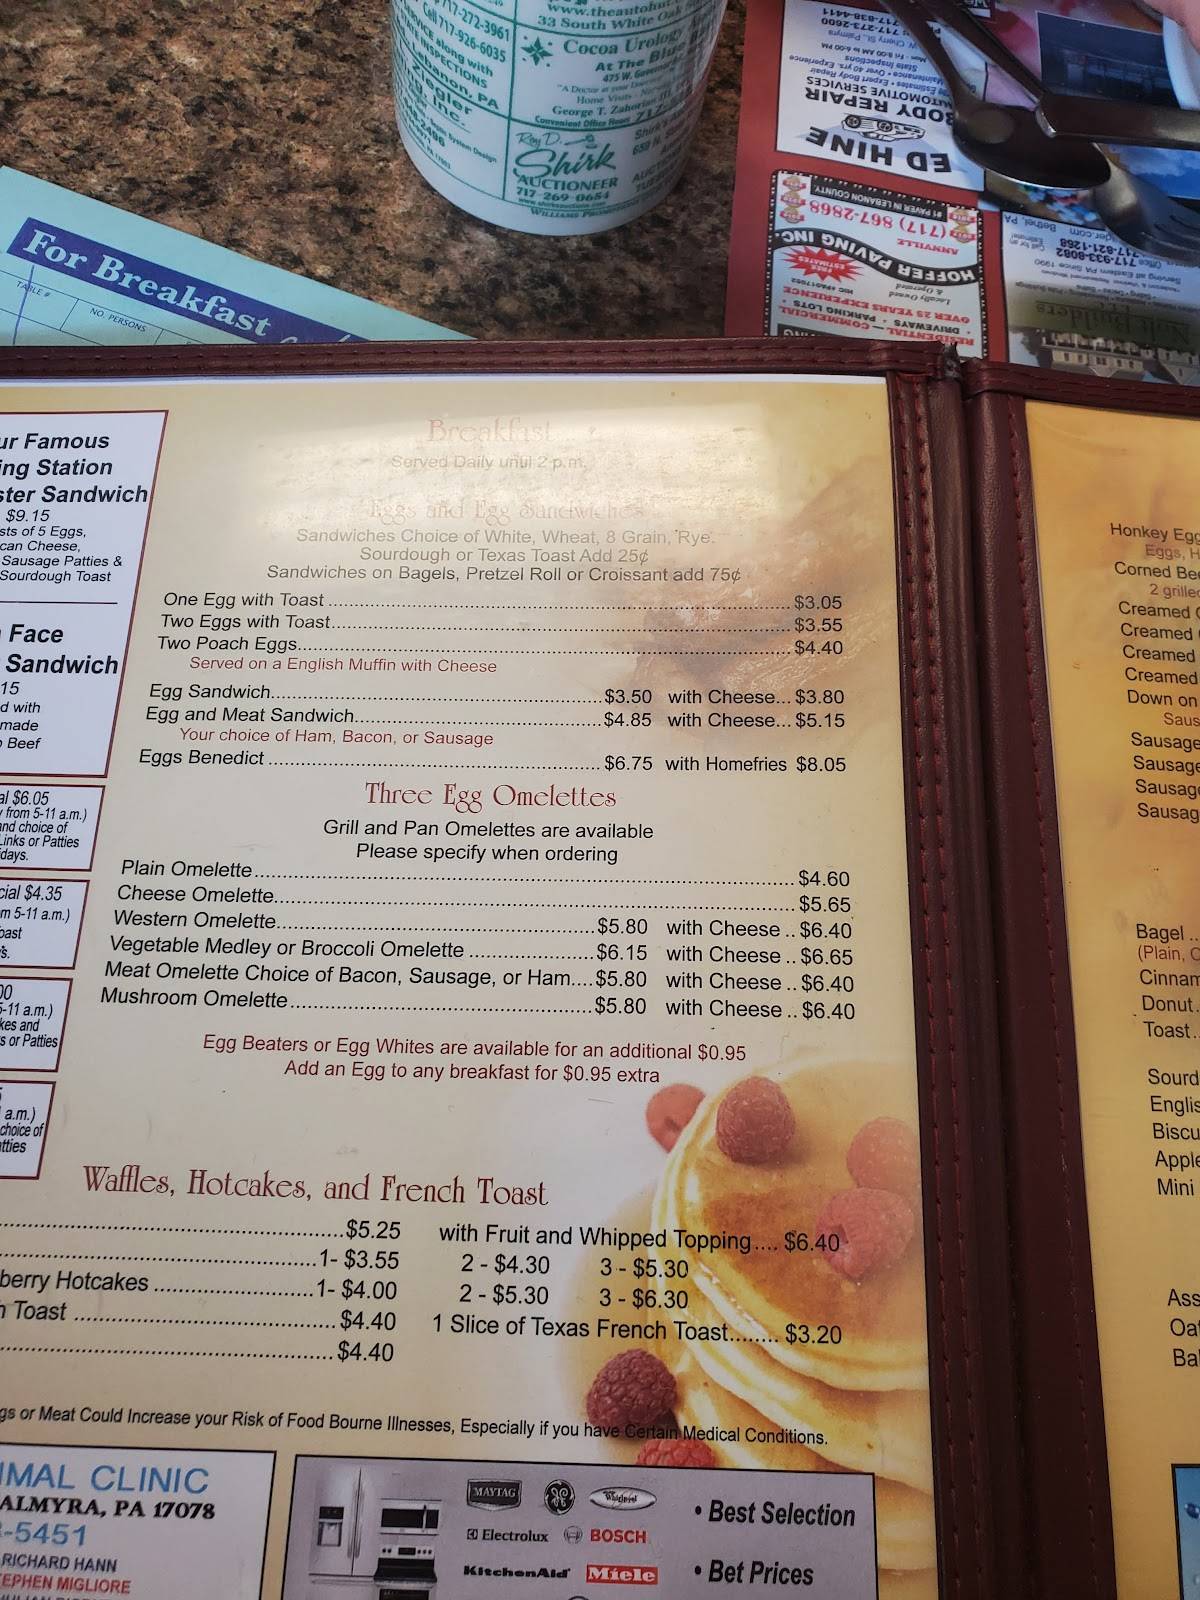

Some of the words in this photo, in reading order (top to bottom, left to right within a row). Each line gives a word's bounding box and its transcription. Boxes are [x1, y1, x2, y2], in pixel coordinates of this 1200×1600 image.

[538, 16, 556, 27] 33
[561, 18, 606, 30] South
[612, 17, 653, 29] White
[821, 18, 898, 35] 717-273-2600
[439, 16, 505, 62] 717-926-6035
[564, 40, 618, 55] Cocoa
[622, 27, 682, 54] Urology
[421, 36, 487, 88] INSPECTIONS
[596, 62, 614, 72] At
[618, 59, 645, 69] The
[789, 55, 835, 68] Experience
[845, 55, 894, 68] Inspections
[853, 65, 864, 73] 40
[897, 62, 918, 72] State
[413, 42, 472, 98] Lebanon,
[478, 93, 498, 109] PA
[866, 67, 886, 77] Over
[413, 64, 471, 114] Ziegler
[806, 76, 866, 93] SERVICES
[805, 88, 888, 112] REPAIR
[806, 127, 892, 166] HINE
[513, 144, 616, 179] Shirk
[906, 152, 952, 173] ED
[517, 177, 618, 190] AUCTIONEER
[851, 192, 892, 208] LEBANON
[893, 202, 901, 210] IN
[809, 200, 893, 228] 867-2868
[903, 204, 930, 216] PAVER
[1004, 215, 1018, 224] PA
[775, 230, 814, 241] INC.
[899, 218, 946, 239] (717)
[822, 233, 892, 270] PAVING
[897, 238, 959, 255] ANNVILLE
[798, 256, 844, 270] ESTIMATES
[1056, 248, 1136, 267] 717-933-8082
[898, 263, 975, 281] HOFFER
[1058, 262, 1082, 272] Since
[1100, 267, 1133, 277] Eastern
[23, 229, 88, 269] For
[92, 254, 271, 337] Breakfast
[1149, 273, 1181, 284] Serving
[16, 281, 42, 294] TABLE
[783, 287, 869, 309] EXPERIENCE
[793, 300, 822, 311] LOTS
[778, 306, 870, 330] COMMERCIAL
[826, 306, 876, 322] PARKING
[872, 303, 913, 317] YEARS
[934, 311, 970, 324] OVER
[90, 308, 107, 318] NO.
[108, 312, 147, 332] PERSONS
[894, 319, 960, 334] DRIVEWAYS
[427, 416, 552, 443] Breakfast
[24, 433, 109, 449] Famous
[37, 459, 112, 475] Station
[42, 485, 147, 502] Sandwich
[6, 509, 50, 523] $9.15
[1110, 523, 1168, 541] Honkey
[2, 555, 59, 568] Sausage
[64, 556, 108, 566] Patties
[113, 555, 123, 567] &
[1115, 562, 1171, 578] Corned
[77, 571, 111, 581] Toast
[267, 565, 366, 578] Sandwiches
[373, 569, 392, 578] on
[400, 566, 459, 582] Bagels,
[467, 567, 523, 580] Pretzel
[531, 568, 560, 580] Roll
[567, 571, 584, 580] or
[589, 568, 668, 581] Croissant
[673, 568, 703, 581] add
[711, 568, 741, 584] 75¢
[1119, 601, 1190, 619] Creamed
[9, 624, 63, 643] Face
[6, 654, 118, 674] Sandwich
[1128, 690, 1172, 705] Down
[1179, 696, 1197, 707] on
[180, 728, 215, 740] Your
[220, 729, 269, 741] choice
[276, 729, 291, 741] of
[296, 730, 335, 743] Ham,
[343, 730, 396, 744] Bacon,
[403, 734, 418, 743] or
[424, 731, 493, 747] Sausage
[140, 749, 182, 767] Eggs
[189, 750, 264, 765] Benedict
[605, 755, 652, 771] $6.75
[665, 757, 699, 770] with
[707, 757, 787, 771] Homefries
[797, 756, 846, 773] $8.05
[366, 782, 432, 804] Three
[443, 783, 482, 813] Egg
[493, 784, 616, 807] Omelettes
[1136, 924, 1183, 943] Bagel
[111, 935, 199, 955] Vegetable
[206, 938, 271, 958] Medley
[277, 943, 296, 955] or
[302, 940, 374, 956] Broccoli
[381, 941, 464, 957] Omelette
[597, 943, 647, 961] $6.15
[667, 946, 702, 961] with
[710, 946, 781, 963] Cheese
[801, 947, 852, 966] $6.65
[1142, 995, 1193, 1012] Donut
[1143, 1021, 1190, 1038] Toast
[83, 1165, 174, 1196] Waffles,
[187, 1170, 311, 1201] Hotcakes,
[325, 1173, 369, 1200] and
[380, 1175, 464, 1203] French
[478, 1177, 548, 1205] Toast
[1158, 1178, 1194, 1196] Mini
[432, 1315, 442, 1332] 1
[451, 1314, 499, 1334] Slice
[506, 1316, 526, 1335] of
[531, 1317, 589, 1336] Texas
[598, 1319, 666, 1339] French
[674, 1321, 728, 1341] Toast
[786, 1323, 841, 1345] $3.20
[461, 1418, 535, 1438] Especially
[540, 1421, 549, 1435] if
[553, 1425, 578, 1439] you
[584, 1422, 618, 1437] have
[625, 1421, 680, 1440] Certain
[684, 1426, 739, 1441] Medical
[745, 1428, 827, 1444] Conditions.
[91, 1465, 208, 1494] CLINIC
[472, 1486, 516, 1499] MAYTAG
[114, 1501, 145, 1517] PA
[154, 1502, 215, 1519] 17078
[708, 1500, 756, 1523] Best
[761, 1501, 855, 1526] Selection
[482, 1529, 548, 1542] Electrolux
[591, 1529, 646, 1543] BOSCH
[2, 1553, 70, 1569] RICHARD
[74, 1558, 117, 1572] HANN
[464, 1566, 569, 1578] KitchenAid
[589, 1568, 654, 1581] Miele
[709, 1559, 744, 1583] Bet
[750, 1561, 813, 1585] Prices
[57, 1577, 131, 1594] MIGLIORE
